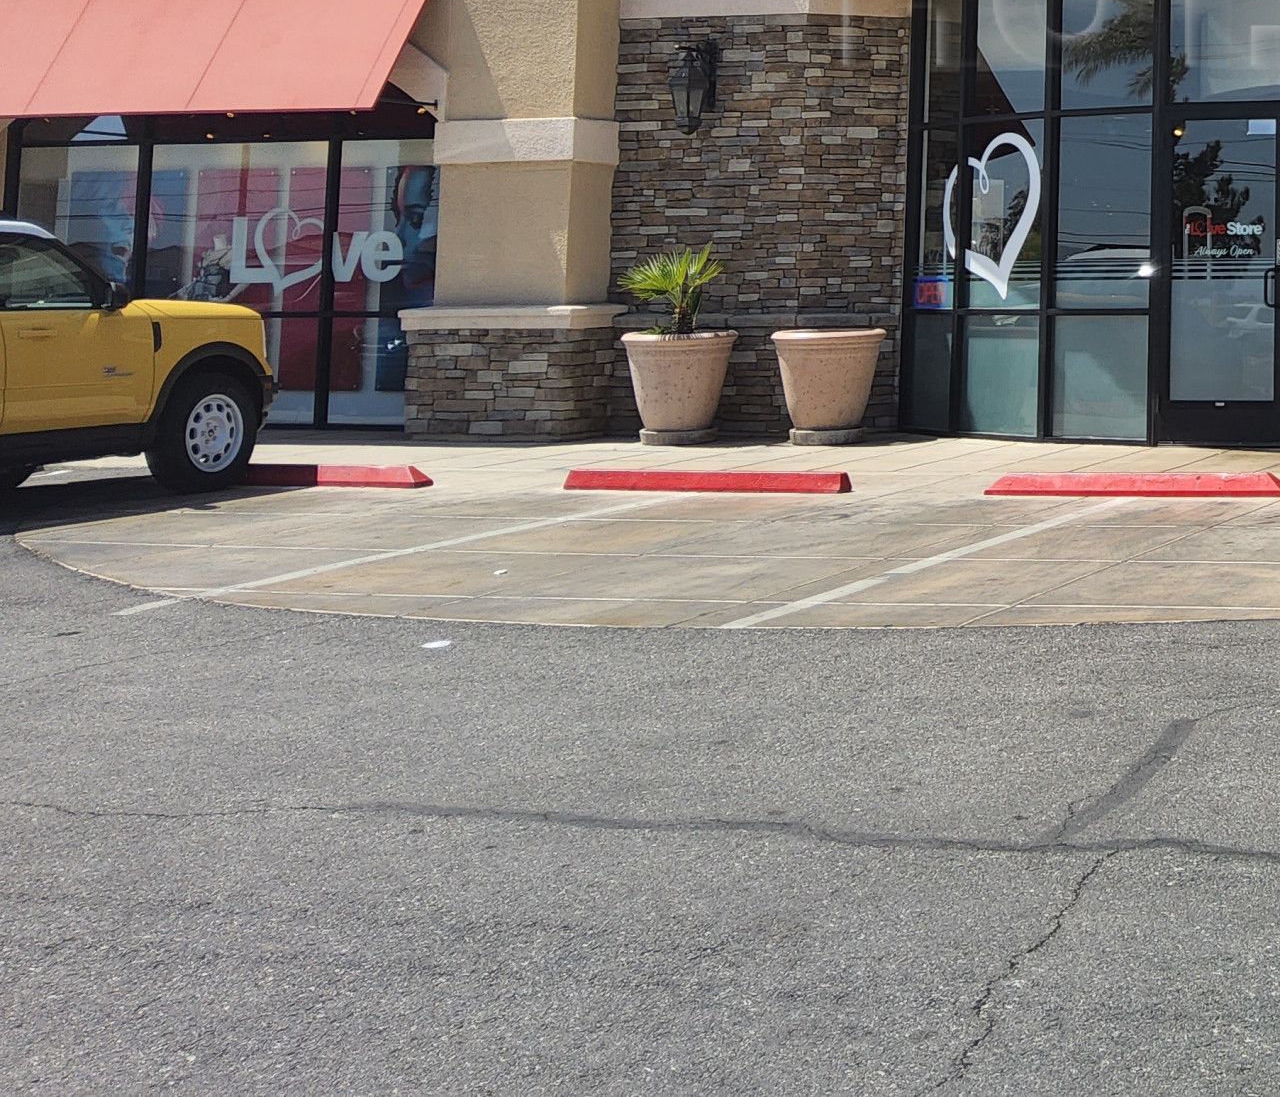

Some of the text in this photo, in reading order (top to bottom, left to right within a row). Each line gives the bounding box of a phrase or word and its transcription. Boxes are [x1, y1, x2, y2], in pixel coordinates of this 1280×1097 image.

[1226, 221, 1264, 235] Store
[1194, 244, 1255, 258] Always Open
